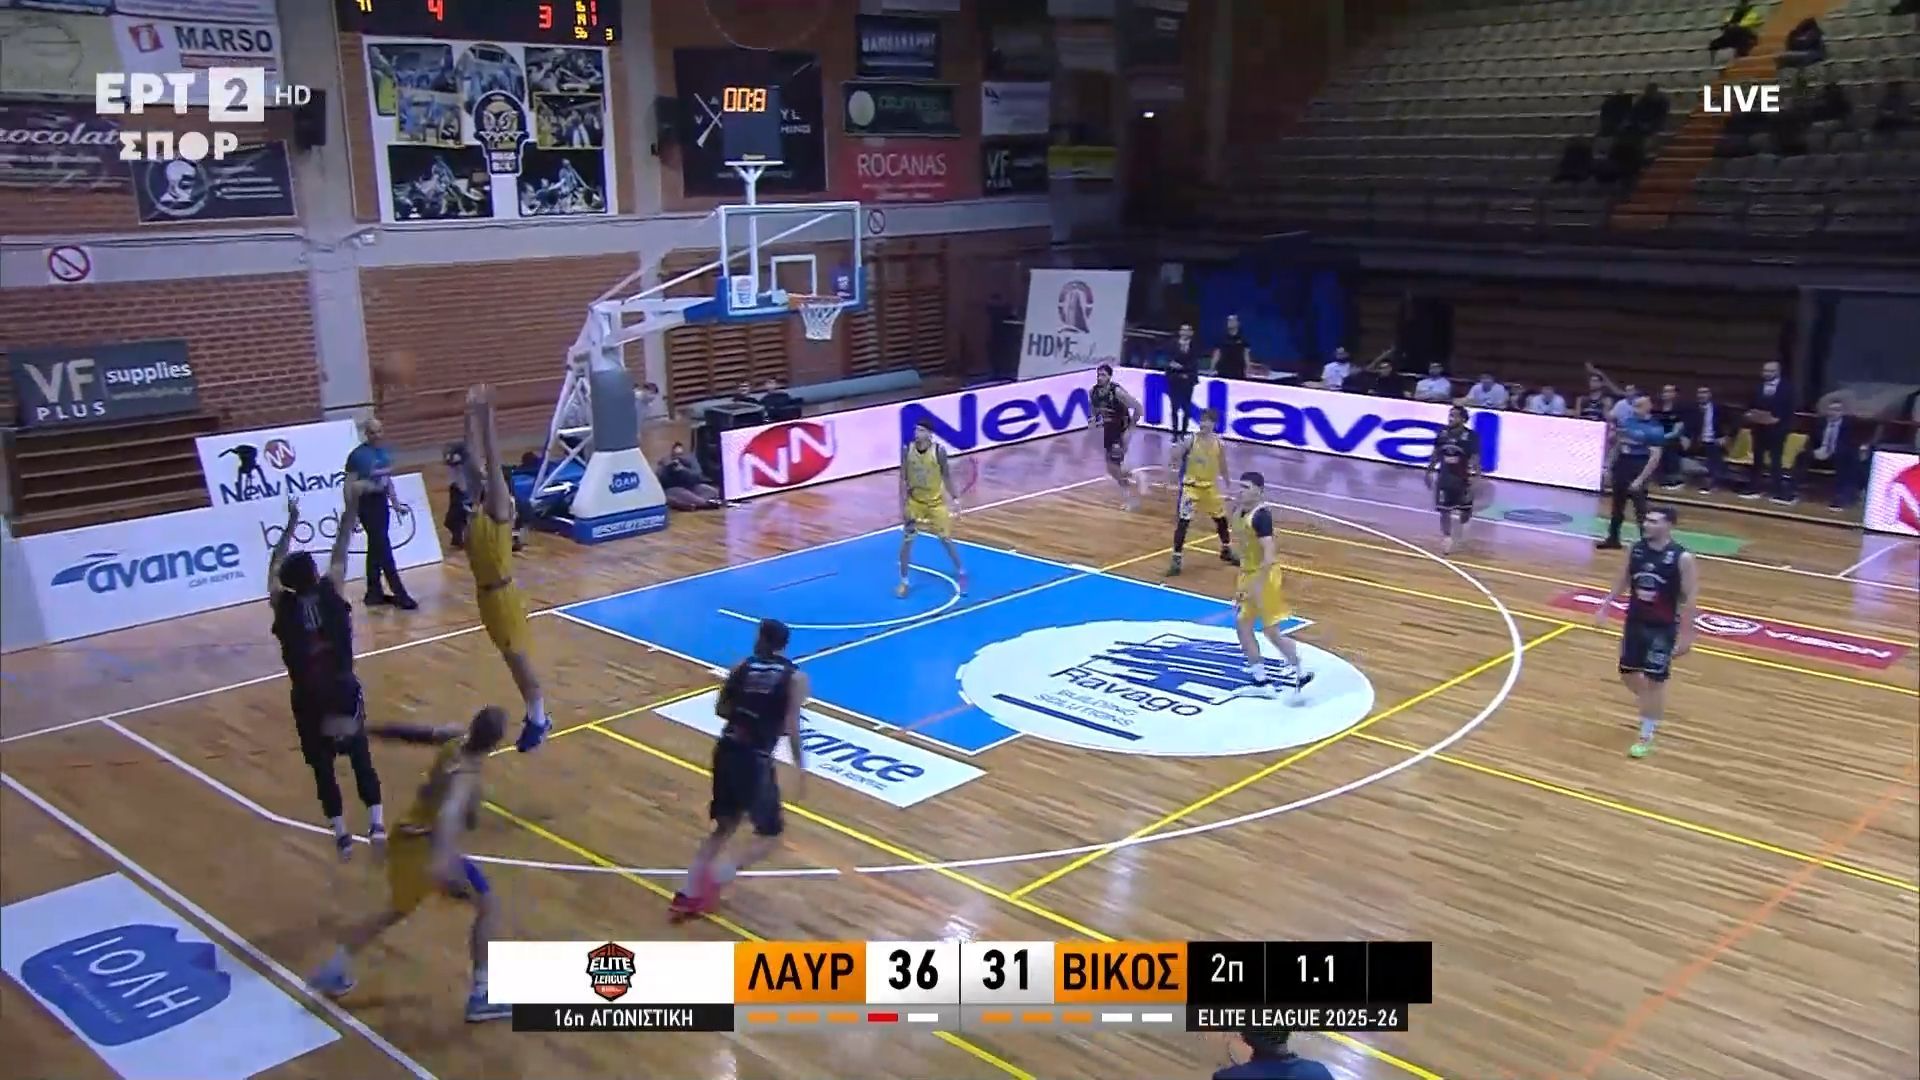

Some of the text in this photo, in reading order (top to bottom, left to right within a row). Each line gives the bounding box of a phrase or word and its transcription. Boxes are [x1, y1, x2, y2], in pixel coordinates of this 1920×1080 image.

[173, 25, 274, 52] MARSO
[857, 153, 948, 177] ROCANAS
[22, 358, 193, 402] VF supplies
[36, 401, 106, 421] PLUS
[900, 373, 1502, 474] New Naval
[218, 471, 348, 505] New Nava
[86, 542, 241, 594] avance
[1049, 666, 1203, 717] Ravago
[800, 727, 925, 783] ance
